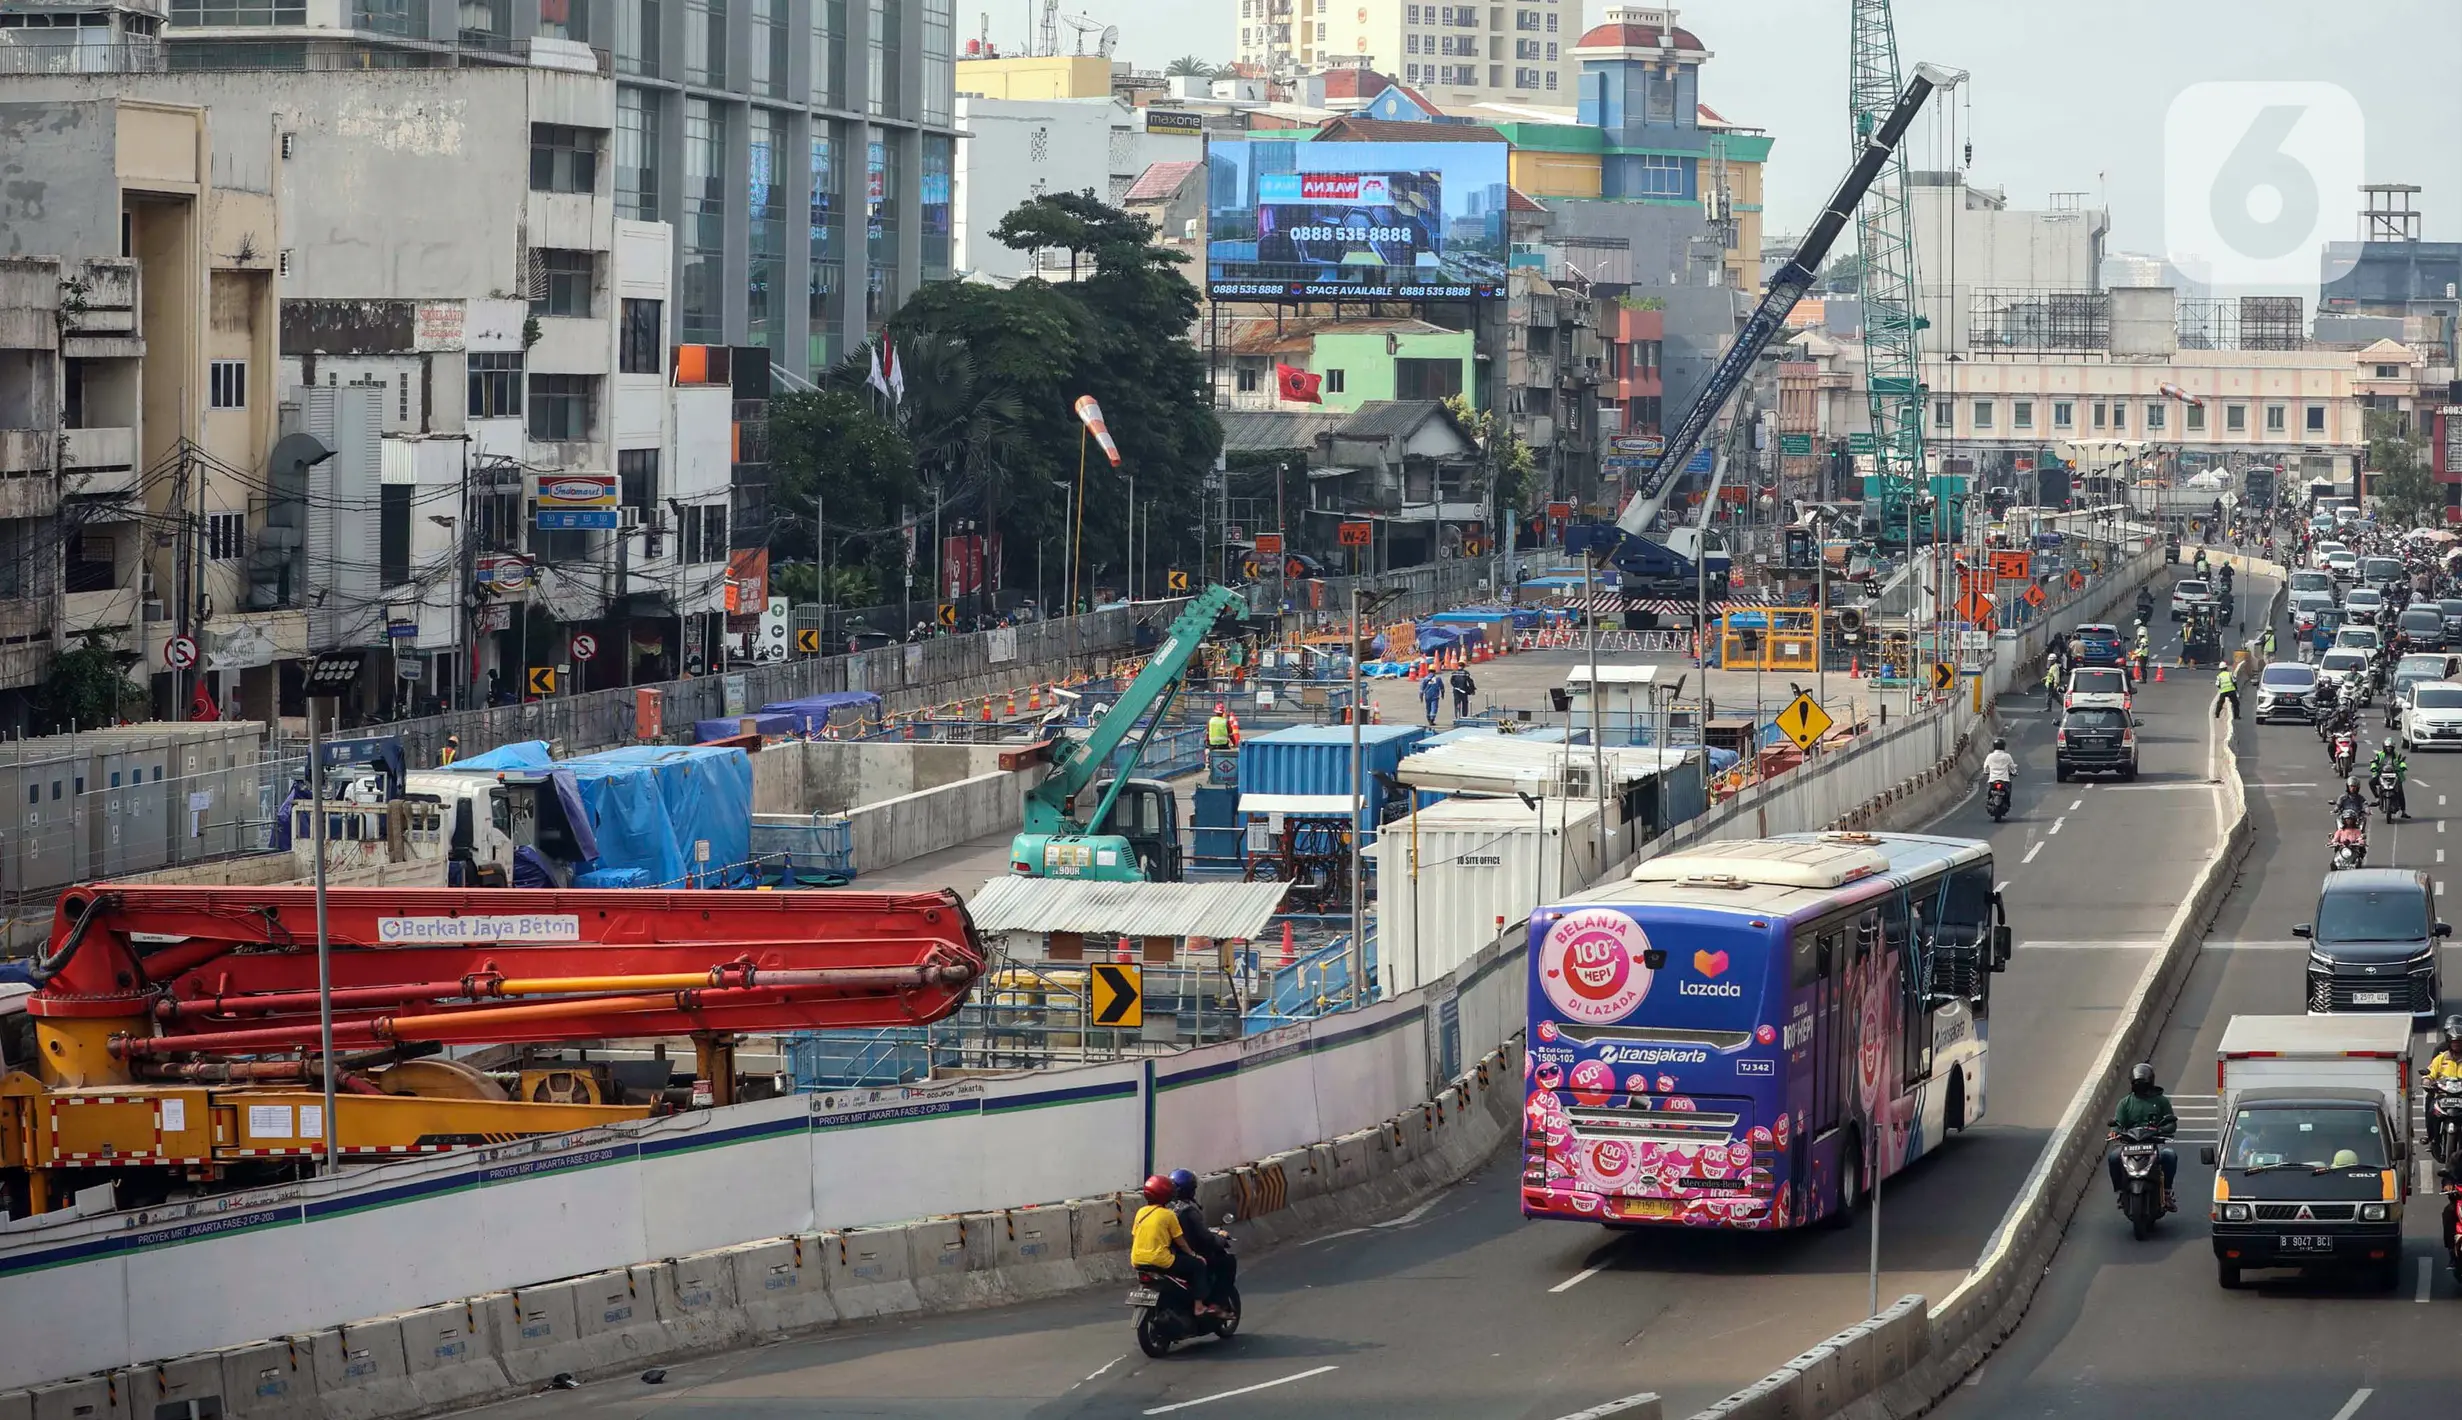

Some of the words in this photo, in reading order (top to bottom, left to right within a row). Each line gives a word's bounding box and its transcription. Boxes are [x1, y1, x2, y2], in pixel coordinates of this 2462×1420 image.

[1150, 114, 1200, 126] maxone
[1290, 227, 1333, 241] 0888
[1335, 227, 1366, 241] 535
[1369, 227, 1411, 242] 8888
[1213, 285, 1238, 294] 0888
[1239, 285, 1257, 294] 535
[1258, 285, 1283, 294] 8888
[1305, 285, 1339, 295] SPACE
[1339, 286, 1393, 296] AVAILABLE
[1400, 287, 1425, 296] 0888
[1426, 287, 1445, 296] 535
[1446, 287, 1471, 296] 8888
[554, 485, 600, 496] Indomaret
[1343, 530, 1367, 542] W-2
[1997, 562, 2024, 576] E-1
[1465, 856, 1479, 865] SITE
[1480, 856, 1501, 865] OFFICE
[403, 919, 467, 936] Berkat
[473, 919, 514, 939] Jaya
[520, 917, 575, 935] Beton
[1555, 915, 1627, 944] BELANJA
[1574, 939, 1618, 964] 100%
[1584, 967, 1611, 981] HEPI
[1680, 980, 1741, 998] Lazada
[1568, 999, 1582, 1011] DI
[1585, 991, 1636, 1016] LAZADA
[1537, 1054, 1574, 1063] 1500-102
[1618, 1045, 1707, 1064] transjakarta
[1752, 1064, 1770, 1072] 342
[819, 1114, 850, 1126] PROYEK
[851, 1112, 867, 1123] MRT
[868, 1109, 900, 1121] JAKARTA
[900, 1106, 926, 1117] FASE-2
[926, 1103, 950, 1114] CP-203
[489, 1164, 518, 1179] PROYEK
[519, 1161, 534, 1175] MRT
[535, 1157, 565, 1172] JAKARTA
[566, 1153, 589, 1166] FASE-2
[590, 1149, 613, 1162] CP-203
[1704, 1166, 1721, 1177] HEPI
[1682, 1178, 1742, 1188] Mercedes-Benz
[1576, 1199, 1593, 1209] HEPI
[138, 1232, 169, 1246] PROYEK
[170, 1227, 187, 1241] MRT
[188, 1222, 222, 1237] JAKARTA
[223, 1217, 248, 1231] FASE-2
[249, 1212, 275, 1225] CP-203
[2281, 1237, 2287, 1246] B
[2293, 1236, 2312, 1247] 9047
